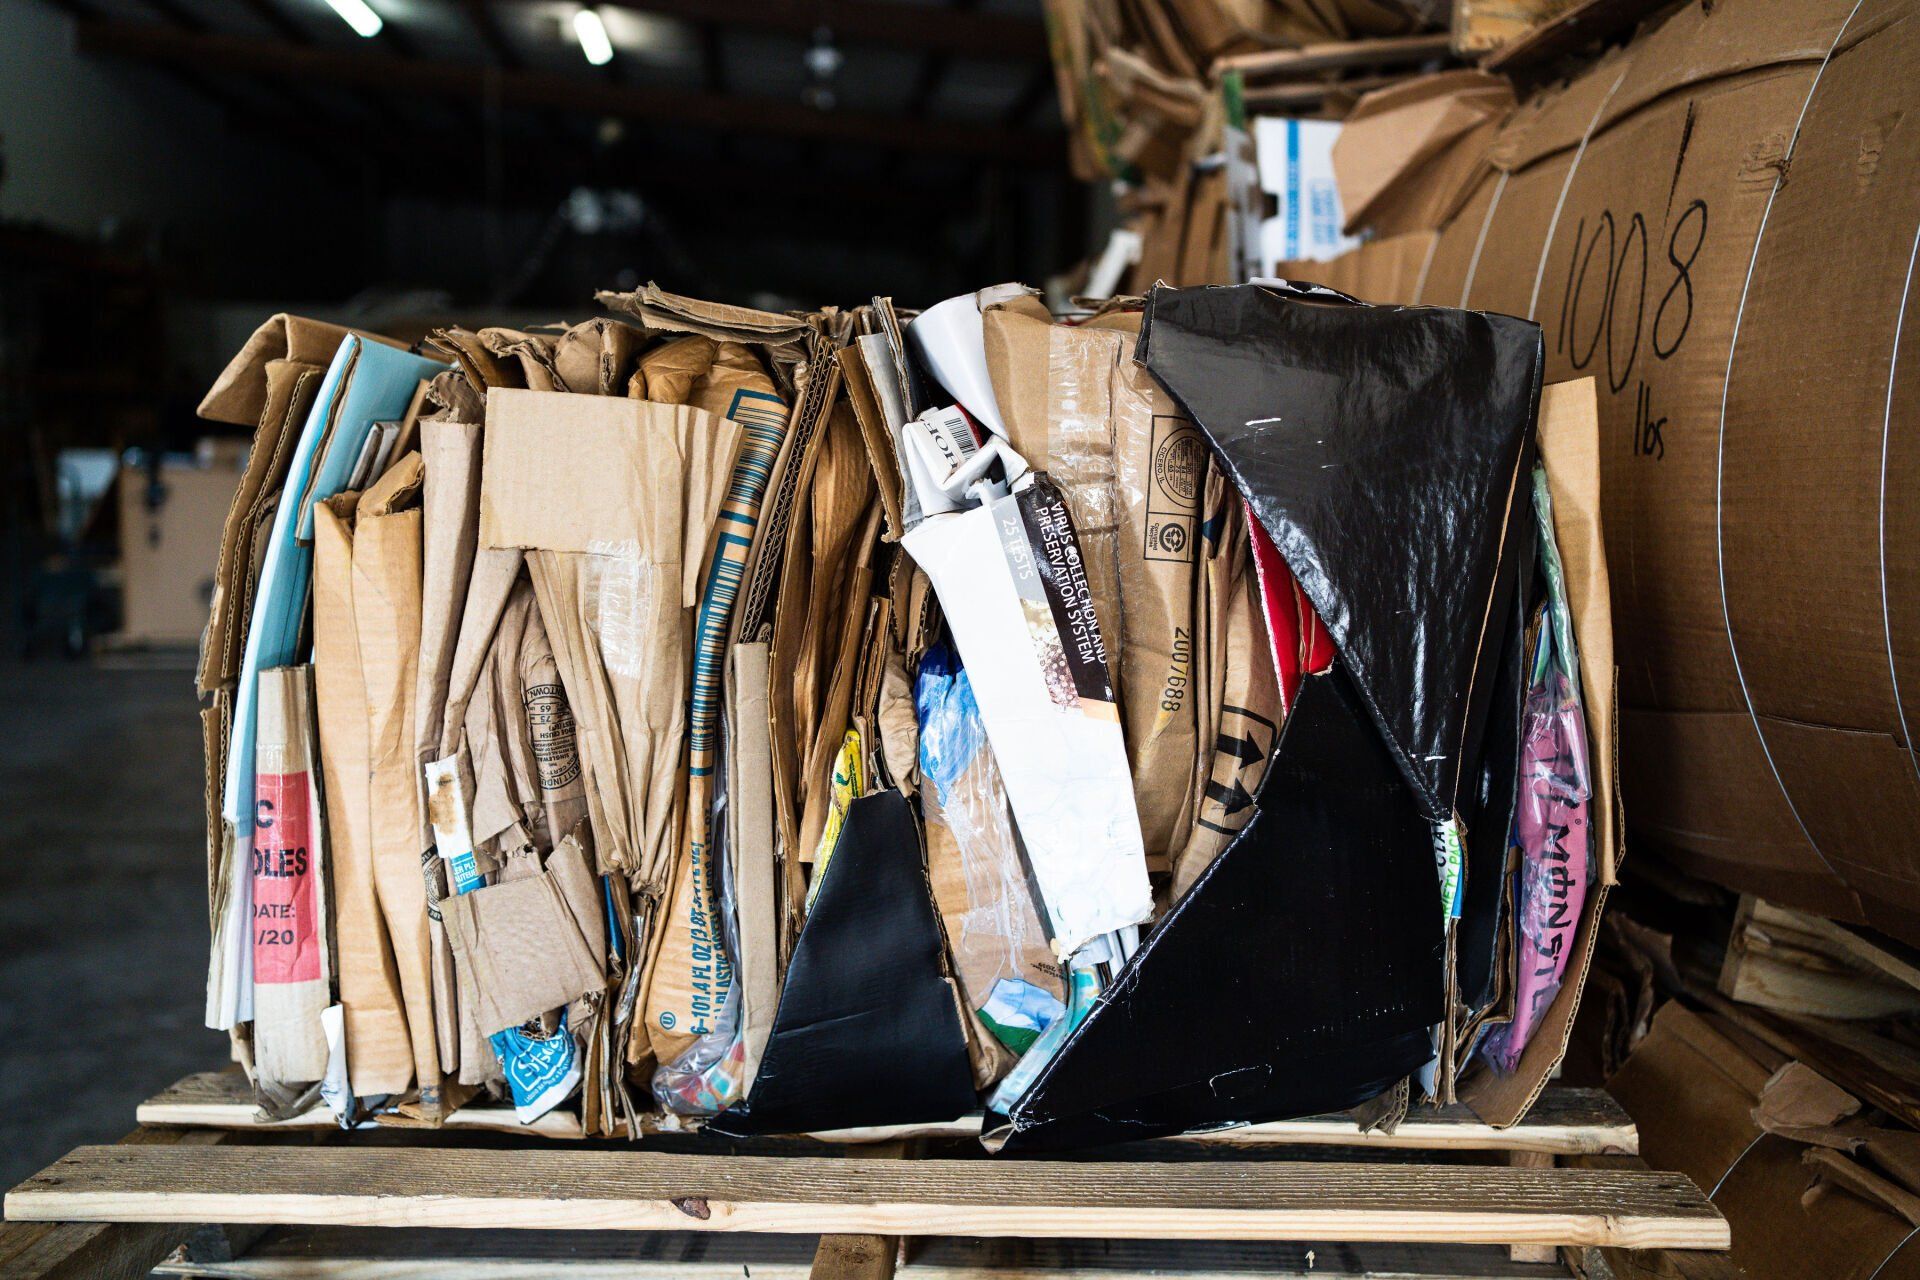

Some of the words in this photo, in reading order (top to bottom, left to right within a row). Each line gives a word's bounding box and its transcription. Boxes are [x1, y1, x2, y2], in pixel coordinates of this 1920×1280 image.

[1558, 199, 1708, 395] 1008
[1634, 380, 1667, 461] lbs
[1003, 519, 1019, 536] 25
[1009, 538, 1033, 580] TESTS
[1035, 508, 1078, 608] PRESERVATION
[1068, 609, 1095, 665] SYSTEM
[1051, 501, 1073, 545] VIRUS
[1064, 546, 1098, 631] COLLECTION
[1091, 632, 1107, 664] AND
[1161, 627, 1189, 712] 2007688
[540, 705, 551, 713] 65
[540, 715, 551, 723] 75
[1448, 828, 1459, 865] PACK
[254, 930, 295, 946] /20
[691, 944, 712, 961] OZ
